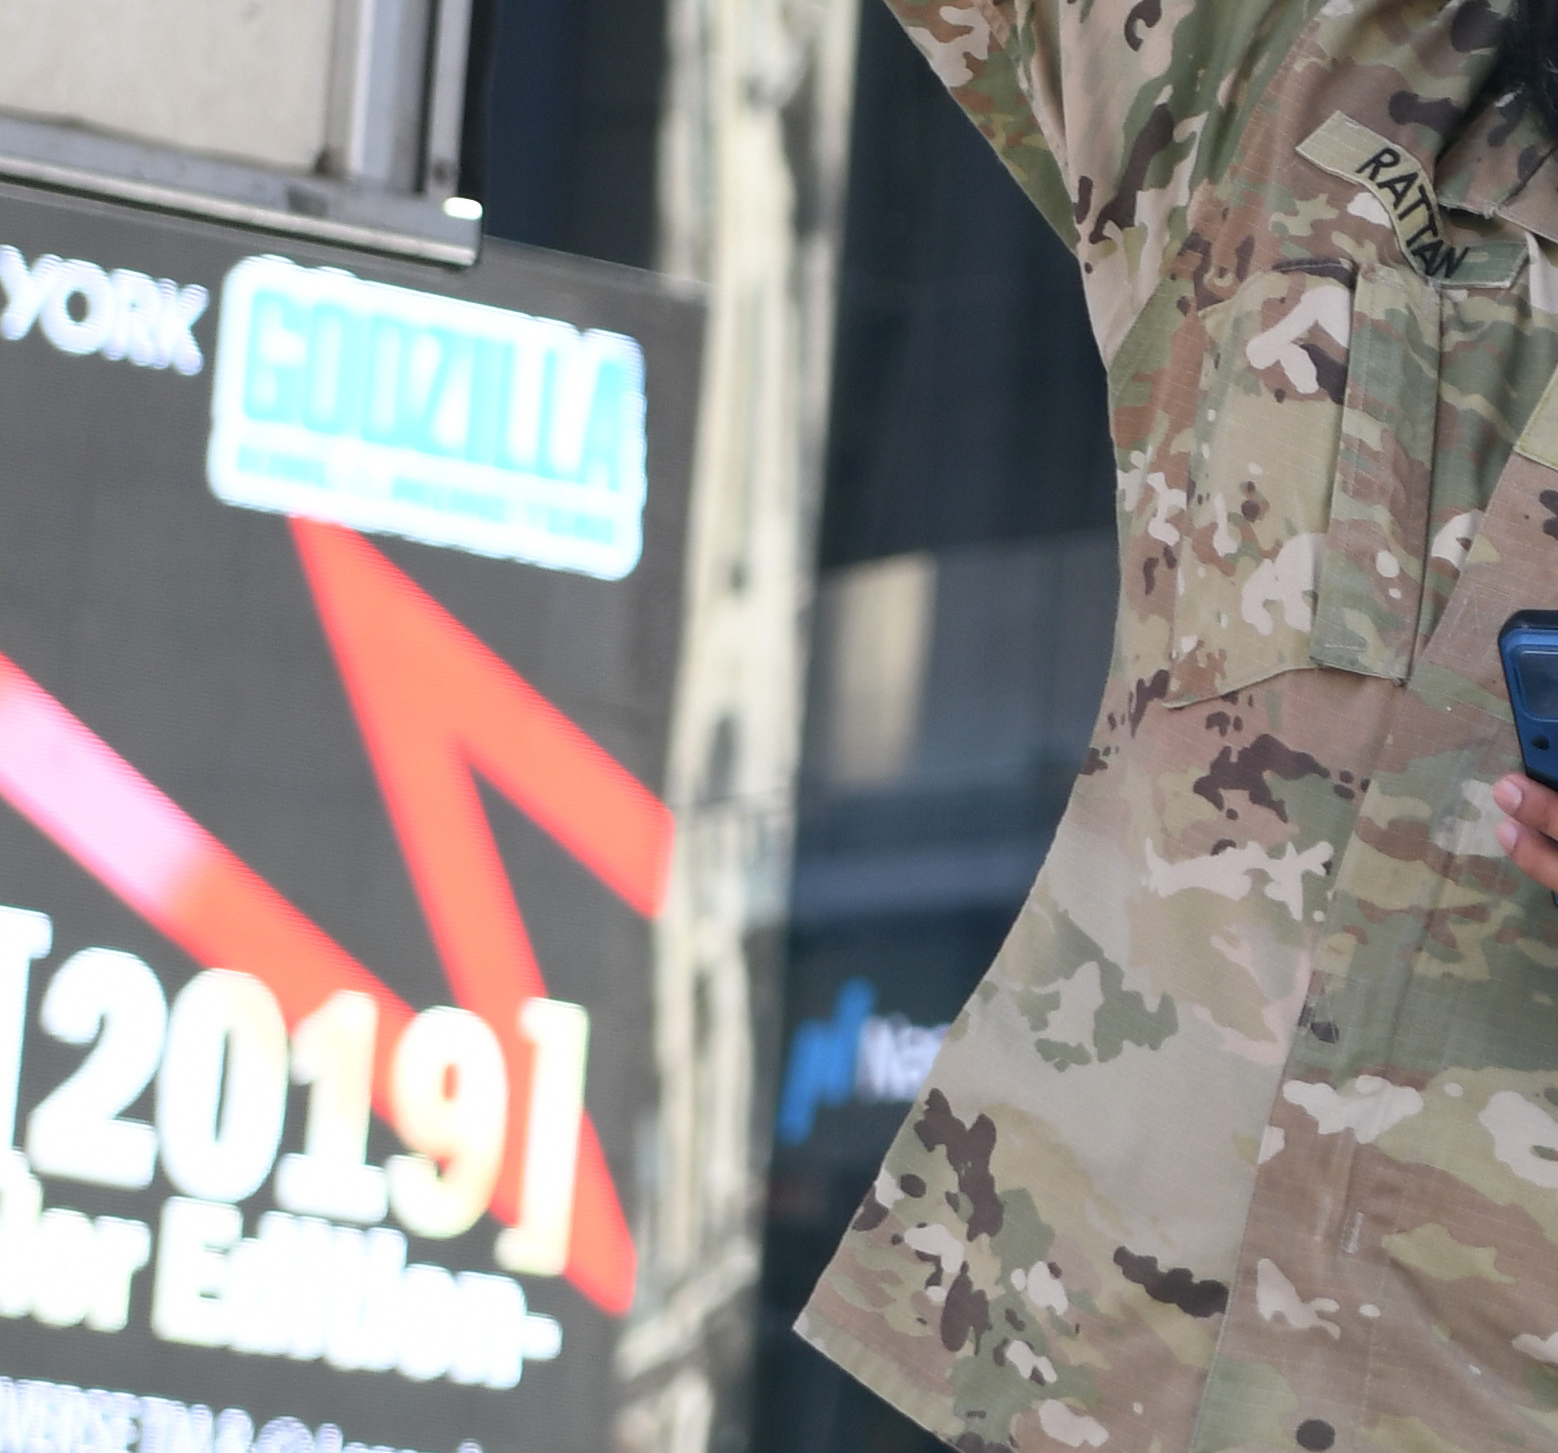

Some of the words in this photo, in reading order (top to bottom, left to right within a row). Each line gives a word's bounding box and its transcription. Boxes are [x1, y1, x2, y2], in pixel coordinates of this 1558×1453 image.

[1355, 147, 1470, 279] RATTAN
[0, 244, 209, 376] YORK
[243, 290, 622, 494] GODZILLA
